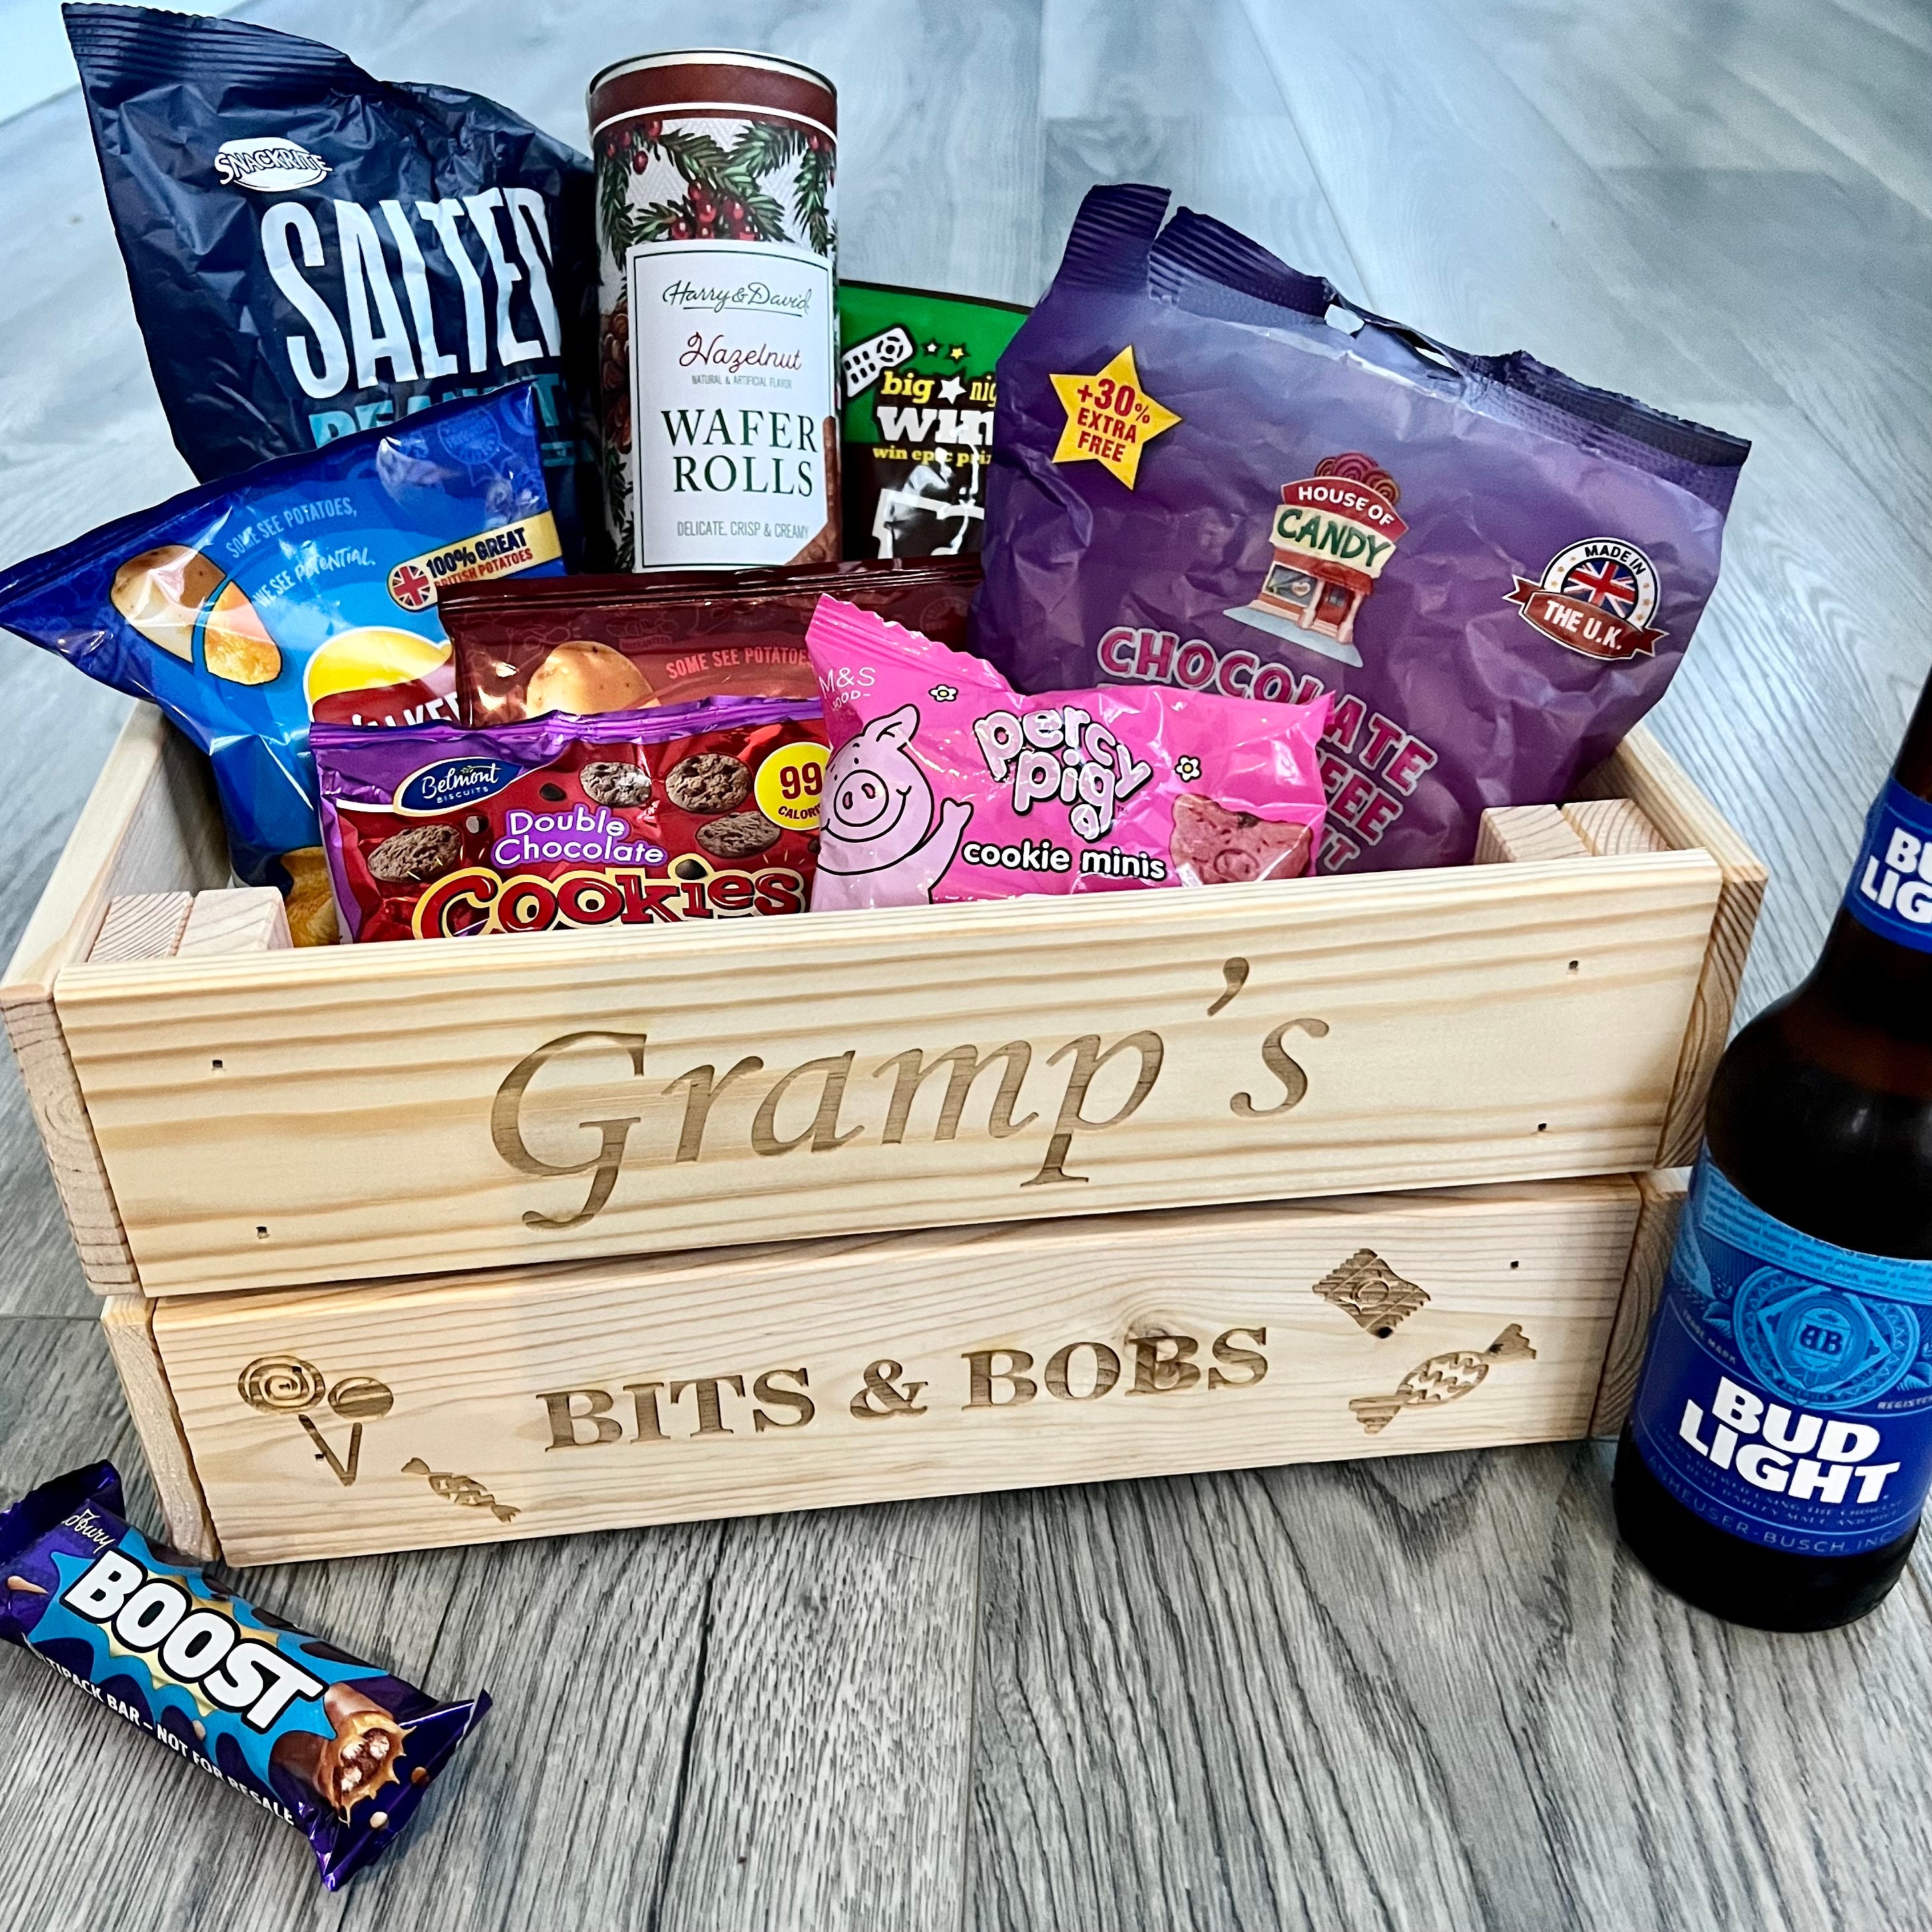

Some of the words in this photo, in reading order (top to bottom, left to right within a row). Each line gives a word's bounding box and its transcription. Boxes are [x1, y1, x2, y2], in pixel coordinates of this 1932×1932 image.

[214, 148, 333, 185] SNACKRITE
[679, 332, 802, 373] Hazelnut
[692, 375, 723, 385] NATURAL
[881, 371, 935, 404] big
[1077, 378, 1150, 423] +30%
[661, 408, 818, 453] WAFER
[1077, 407, 1137, 443] EXTRA
[873, 445, 907, 460] win
[911, 450, 953, 465] epc
[1077, 431, 1126, 463] FREE
[673, 455, 813, 497] ROLLS
[1298, 486, 1369, 511] HOUSE
[1368, 505, 1394, 525] OF
[226, 526, 261, 559] SOME
[256, 515, 284, 539] SEE
[283, 497, 358, 529] POTATOES,
[730, 521, 761, 536] CRISP
[764, 523, 772, 537] &
[775, 523, 810, 540] CREAMY
[1278, 509, 1391, 567] CANDY
[426, 547, 477, 578] 100%
[475, 527, 527, 561] GREAT
[479, 548, 533, 578] POTATOES
[1584, 545, 1632, 563] MADE
[1629, 558, 1646, 575] IN
[252, 584, 278, 608] WE
[269, 570, 296, 595] SEE
[1543, 600, 1583, 632] THE
[1582, 618, 1622, 650] U.K.
[666, 653, 708, 680] SOME
[713, 648, 740, 668] SEE
[745, 646, 814, 667] POTATOE
[818, 667, 876, 699] M&S
[973, 706, 1153, 799] percy
[422, 763, 501, 800] Belmont
[437, 786, 489, 804] BISCUITS
[780, 762, 823, 800] 99
[1013, 749, 1116, 842] pig
[509, 806, 625, 837] Double
[494, 836, 664, 865] Chocolate
[963, 840, 1071, 871] cookie
[1081, 847, 1166, 879] minis
[413, 863, 806, 940] Cookies
[491, 955, 1330, 1231] Gramp's
[536, 1367, 816, 1453] BITS
[849, 1359, 929, 1421] &
[961, 1326, 1268, 1411] BOBS
[1712, 1376, 1881, 1463] BUD
[1679, 1399, 1901, 1505] LIGHT
[62, 1550, 327, 1730] BOOST
[107, 1693, 140, 1727] BAR
[156, 1723, 188, 1758] NOT
[192, 1750, 226, 1782] FOR
[227, 1775, 294, 1826] RESALE
